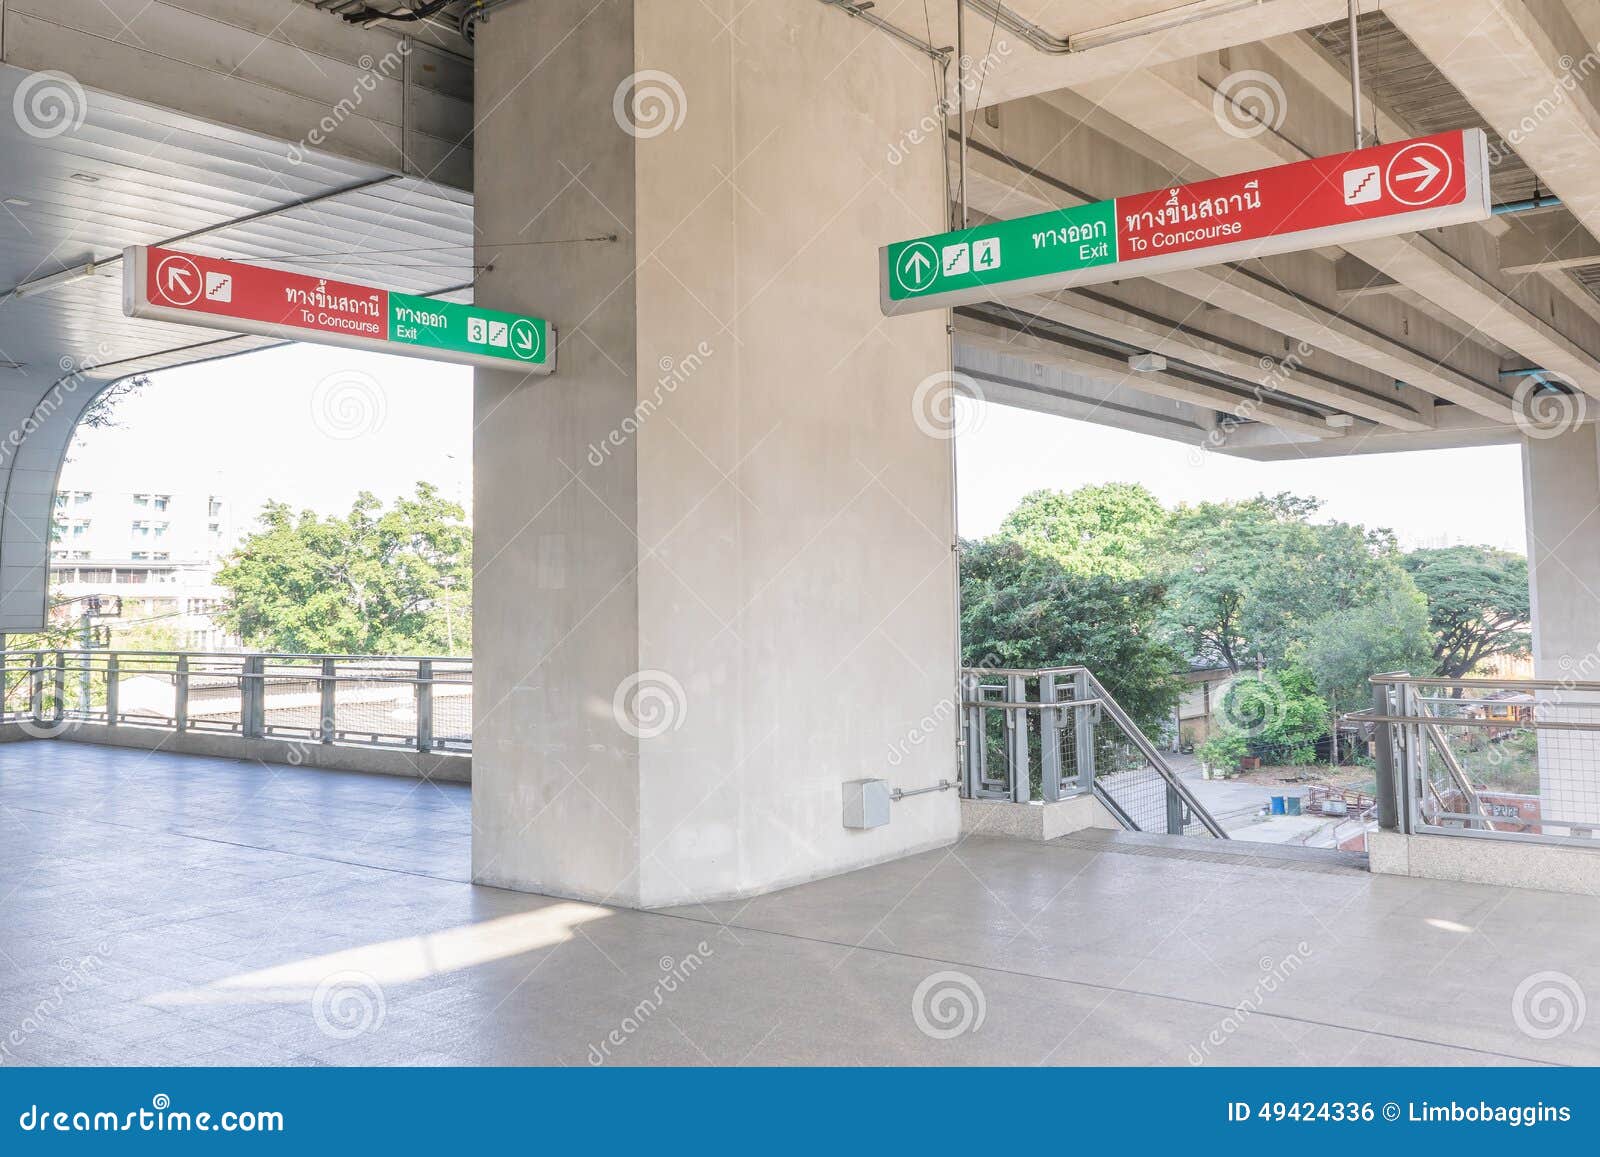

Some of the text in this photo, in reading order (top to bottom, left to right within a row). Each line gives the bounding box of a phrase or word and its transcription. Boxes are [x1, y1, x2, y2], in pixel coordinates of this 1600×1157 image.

[1126, 179, 1261, 232] ทางขึ้นสถานี
[1032, 220, 1107, 249] ทางออก
[1128, 221, 1242, 252] To Concourse
[980, 246, 993, 267] 4
[1079, 241, 1108, 260] Exit
[285, 279, 380, 317] ทางขึ้นสถานี
[300, 309, 380, 333] To Concourse
[395, 306, 448, 329] ทางออก
[396, 324, 418, 340] Exit
[473, 325, 482, 341] 3
